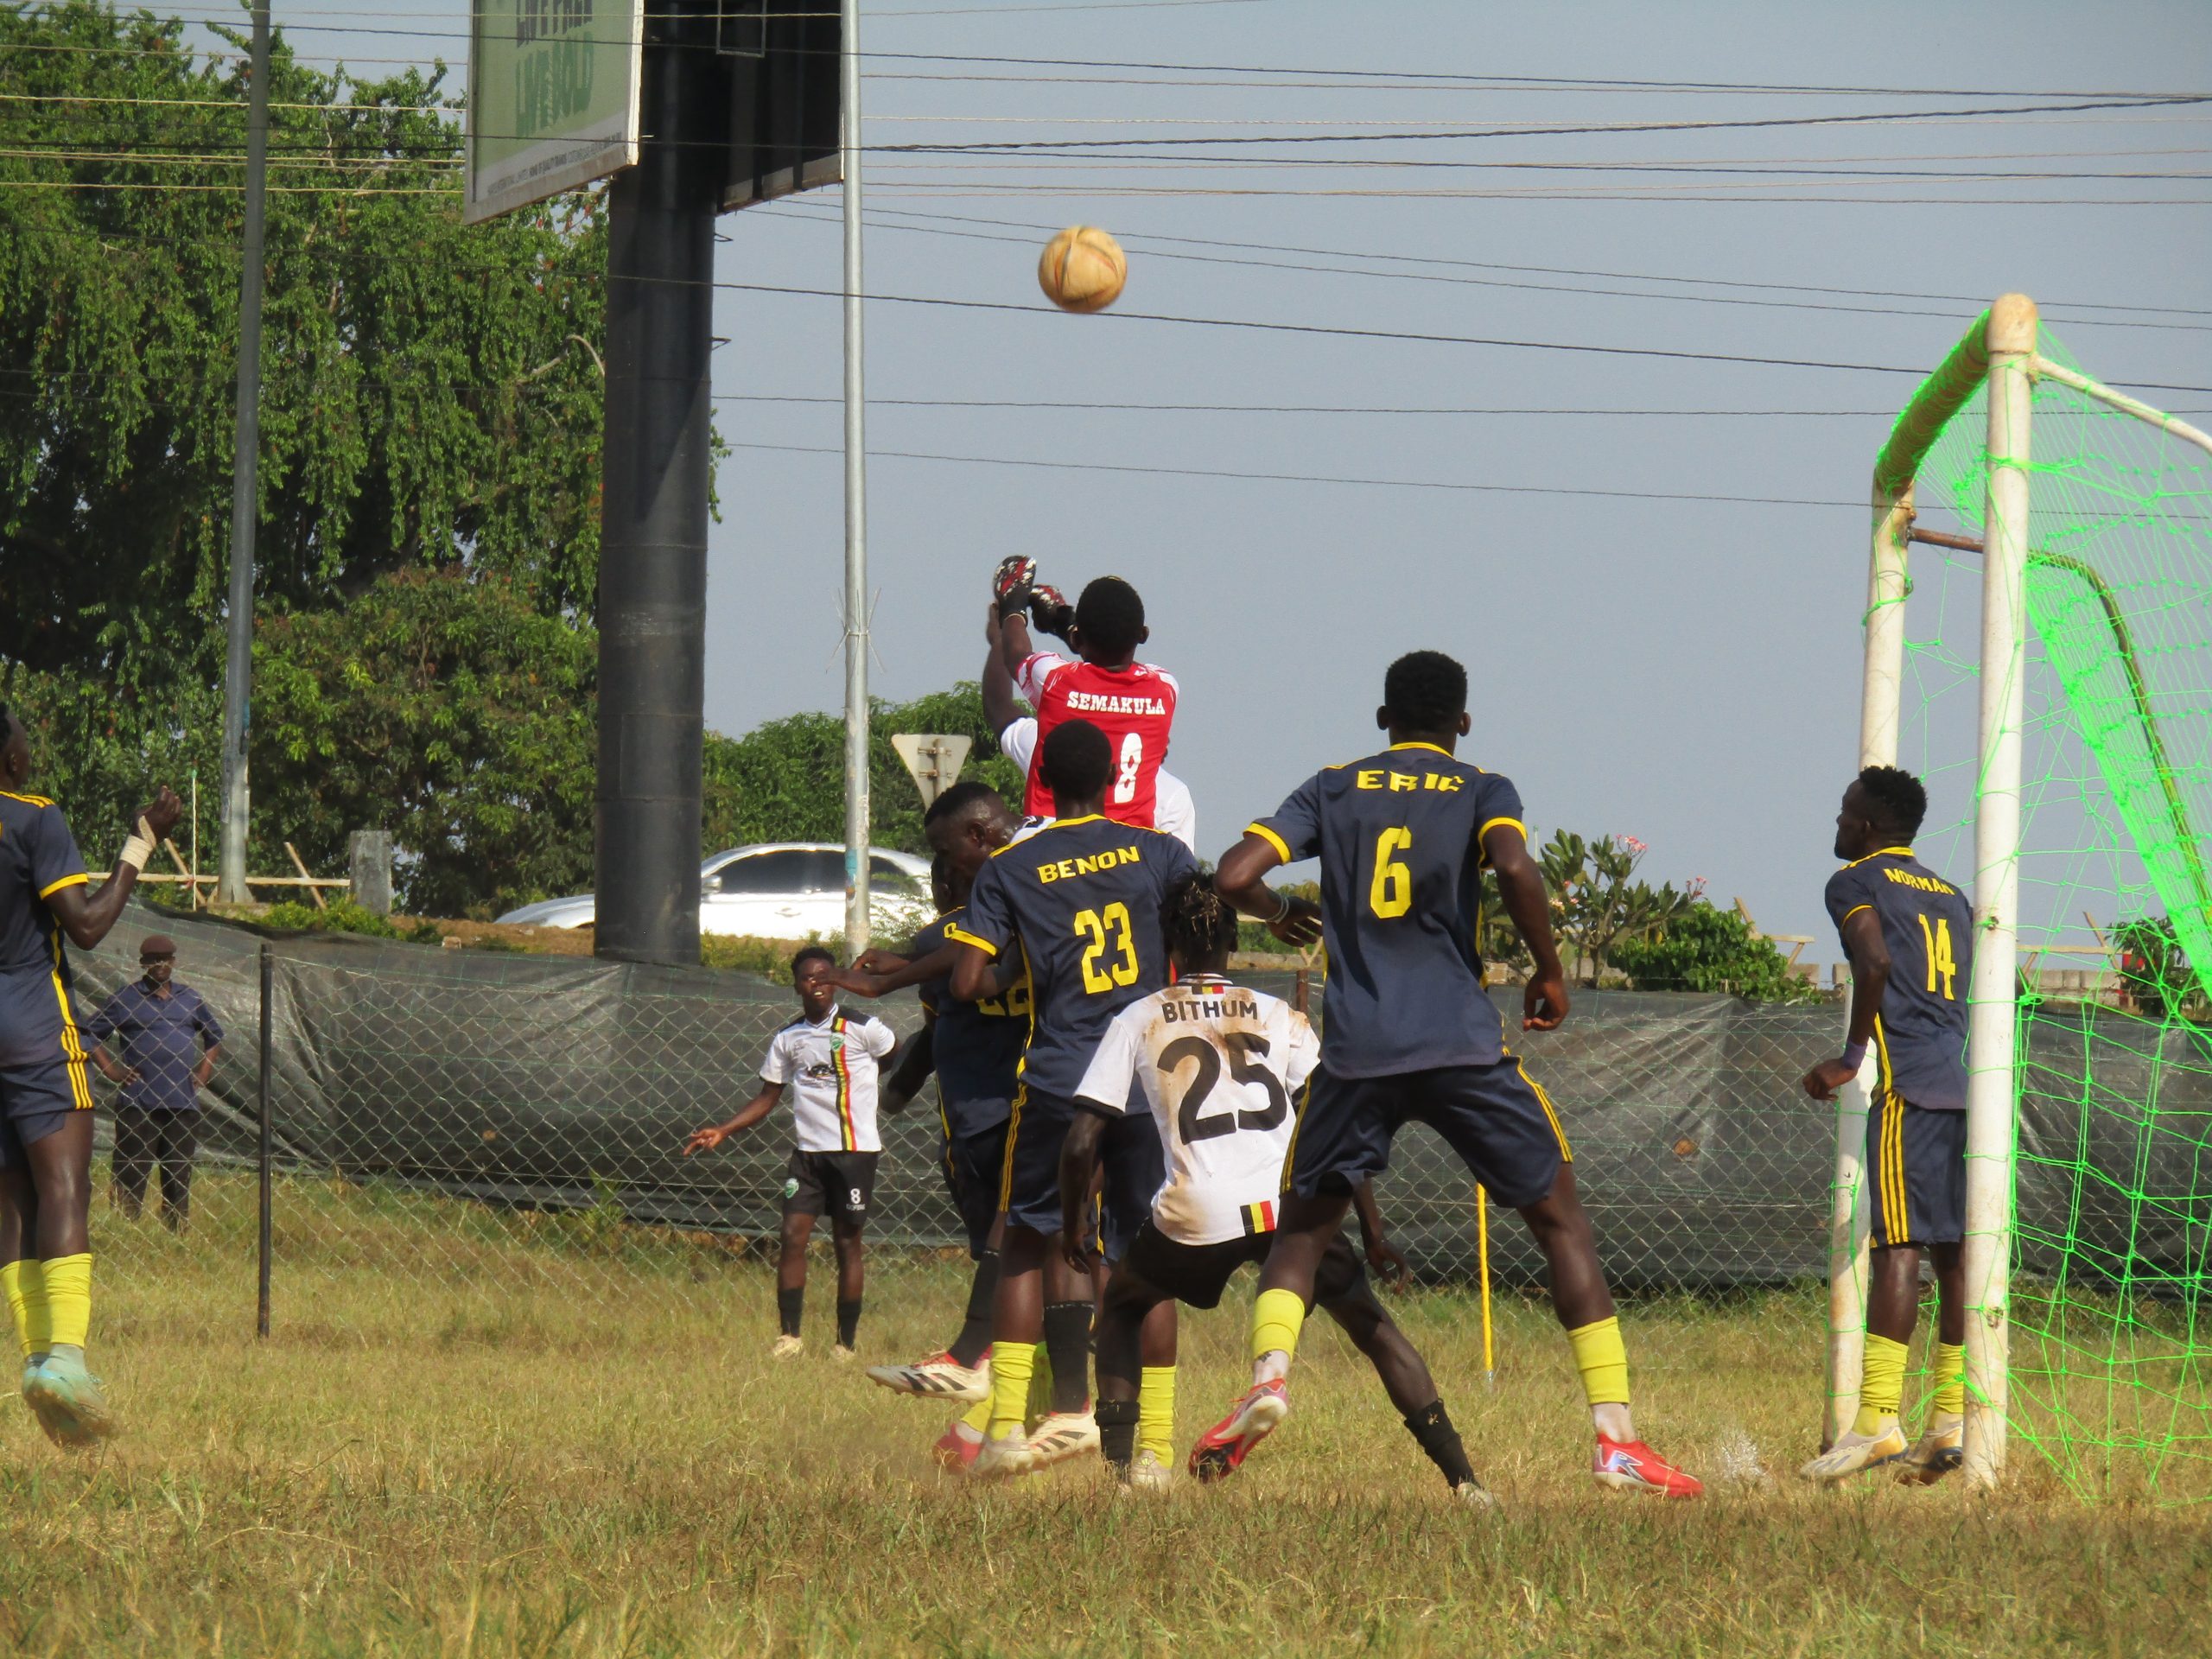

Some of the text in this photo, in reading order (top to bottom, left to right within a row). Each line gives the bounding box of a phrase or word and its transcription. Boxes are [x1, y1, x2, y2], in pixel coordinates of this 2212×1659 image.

[1067, 691, 1165, 715] SEMAKULA
[1115, 733, 1142, 803] 8
[1357, 770, 1464, 791] ERIC
[1038, 846, 1140, 883] BENON
[1370, 827, 1411, 918] 6
[1883, 868, 1955, 893] NORMAN
[1074, 902, 1139, 994] 23
[1918, 914, 1955, 1000] 14
[1162, 1000, 1258, 1023] BITHUM
[1157, 1032, 1287, 1146] 25
[850, 1188, 861, 1204] 8
